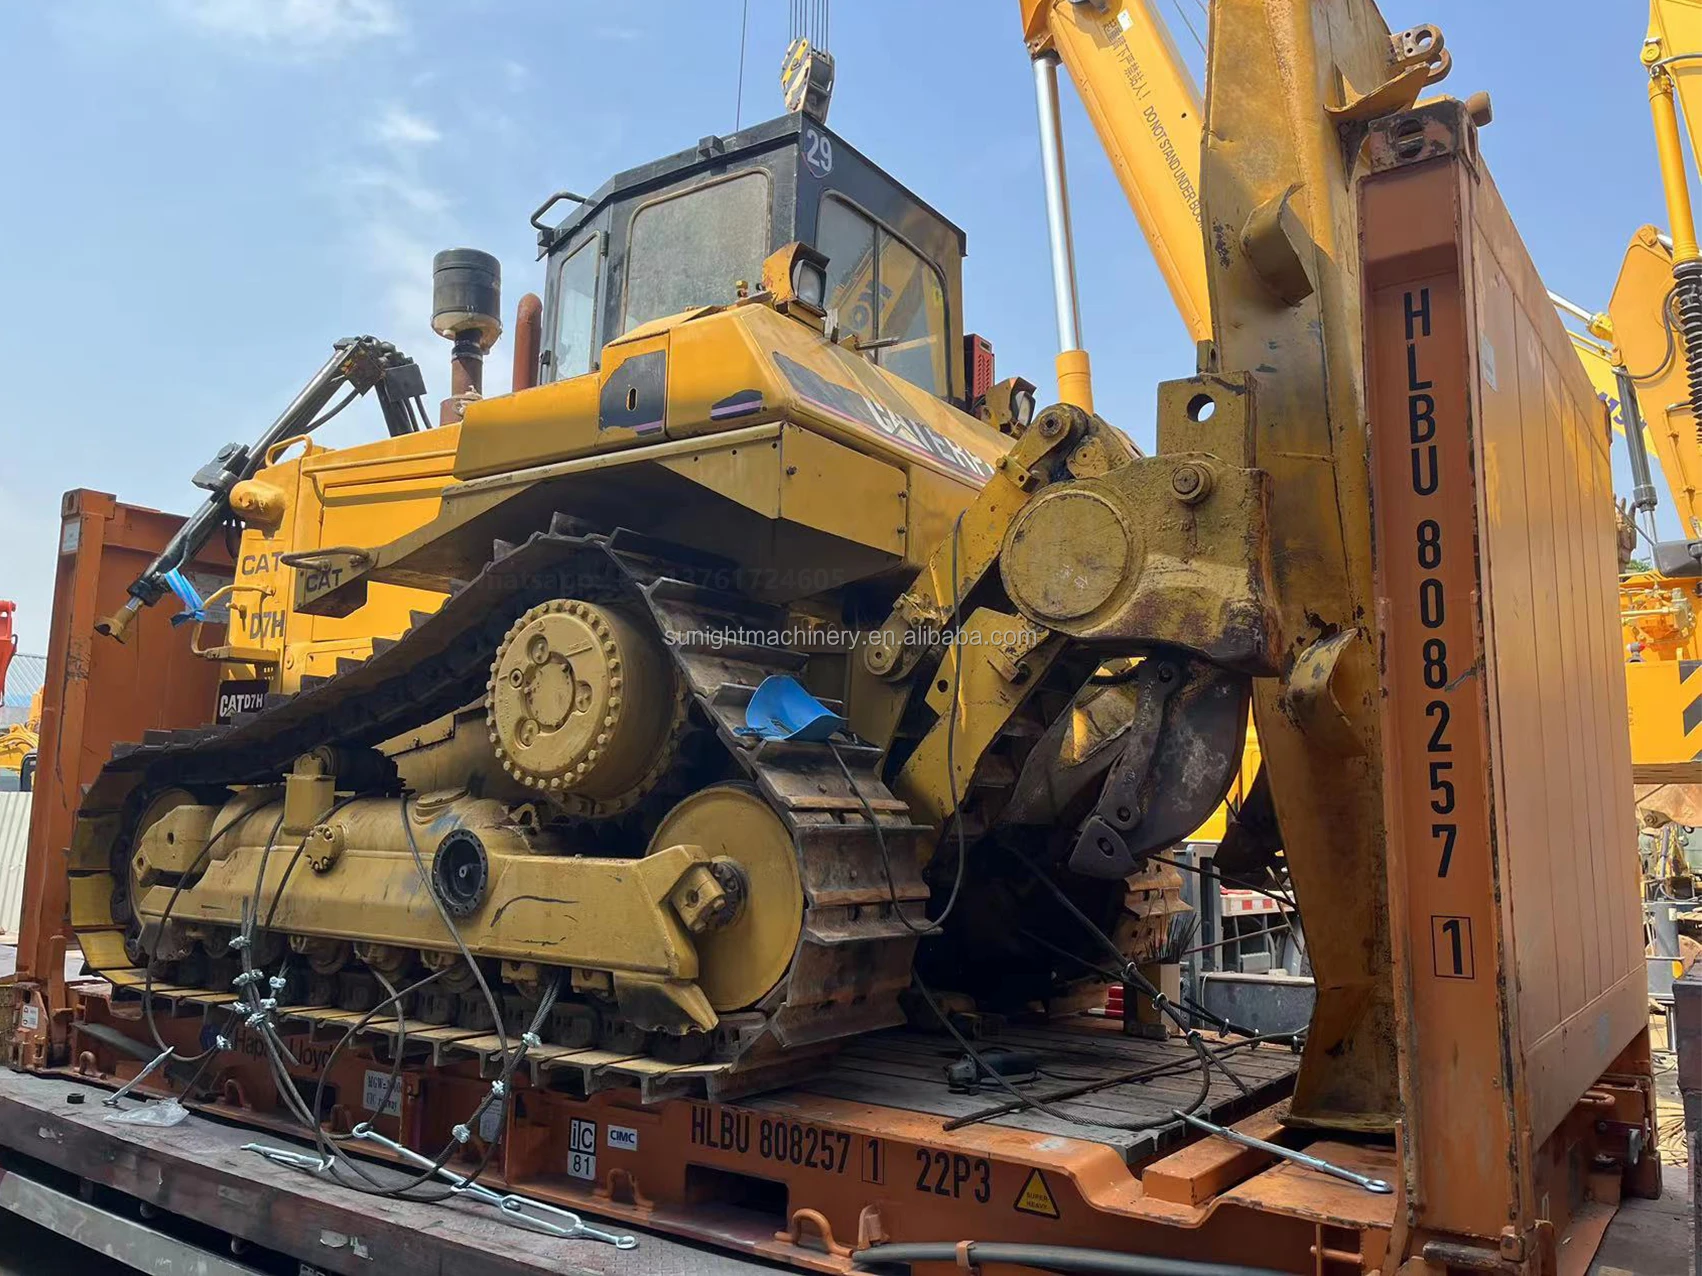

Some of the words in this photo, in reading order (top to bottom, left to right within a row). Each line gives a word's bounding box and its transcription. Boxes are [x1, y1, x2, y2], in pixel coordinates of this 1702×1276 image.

[806, 128, 833, 172] 29
[1143, 105, 1157, 122] DO
[1151, 119, 1167, 141] NOT
[1160, 139, 1181, 171] STAND
[1173, 167, 1196, 203] UNDER
[1404, 288, 1438, 496] HLBU
[242, 551, 285, 576] CAT
[306, 568, 343, 592] CAT
[250, 610, 285, 640] D7H
[1416, 519, 1457, 878] 808257
[1442, 920, 1463, 975] 1
[610, 1129, 636, 1144] CIMC
[691, 1104, 751, 1153] HLBU
[759, 1119, 851, 1174] 808257
[867, 1139, 879, 1181] 1
[572, 1154, 590, 1176] 81
[916, 1148, 990, 1203] 22P3
